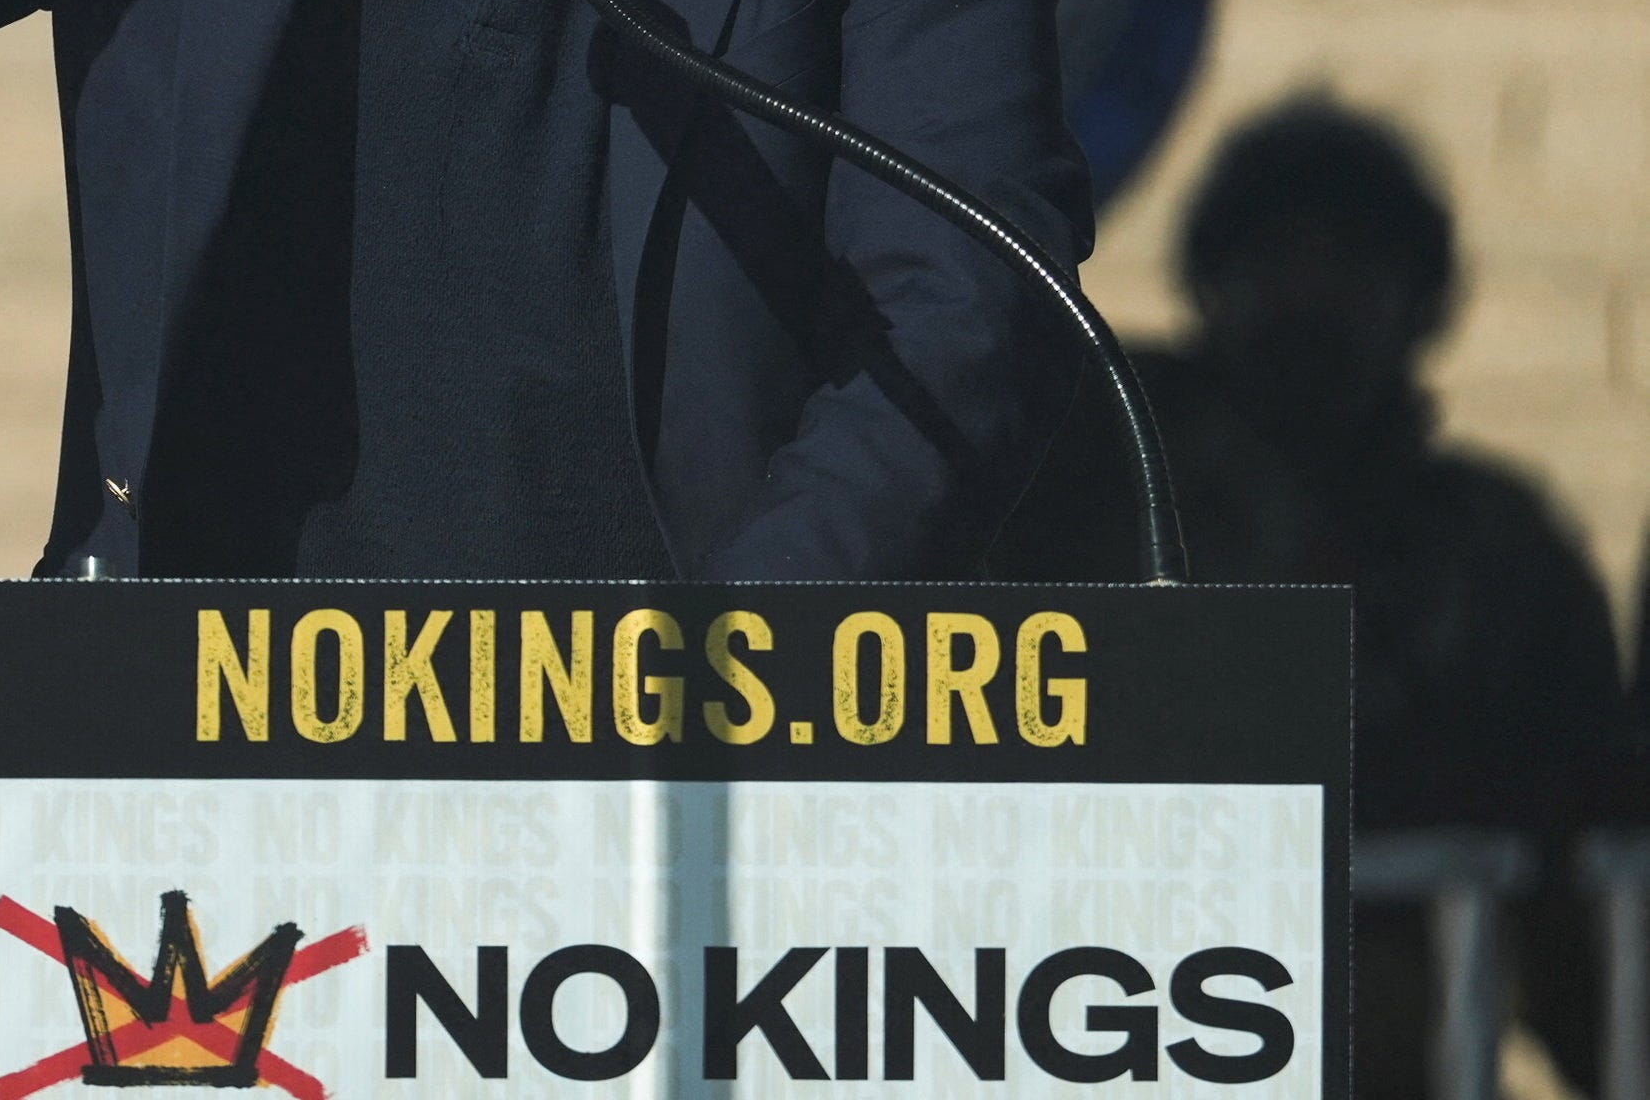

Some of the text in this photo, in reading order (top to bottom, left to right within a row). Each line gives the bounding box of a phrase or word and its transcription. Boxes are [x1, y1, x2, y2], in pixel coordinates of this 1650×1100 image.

[195, 608, 1088, 748] NOKINGS.ORG
[385, 943, 661, 1082] NO
[702, 945, 1296, 1084] KINGS
